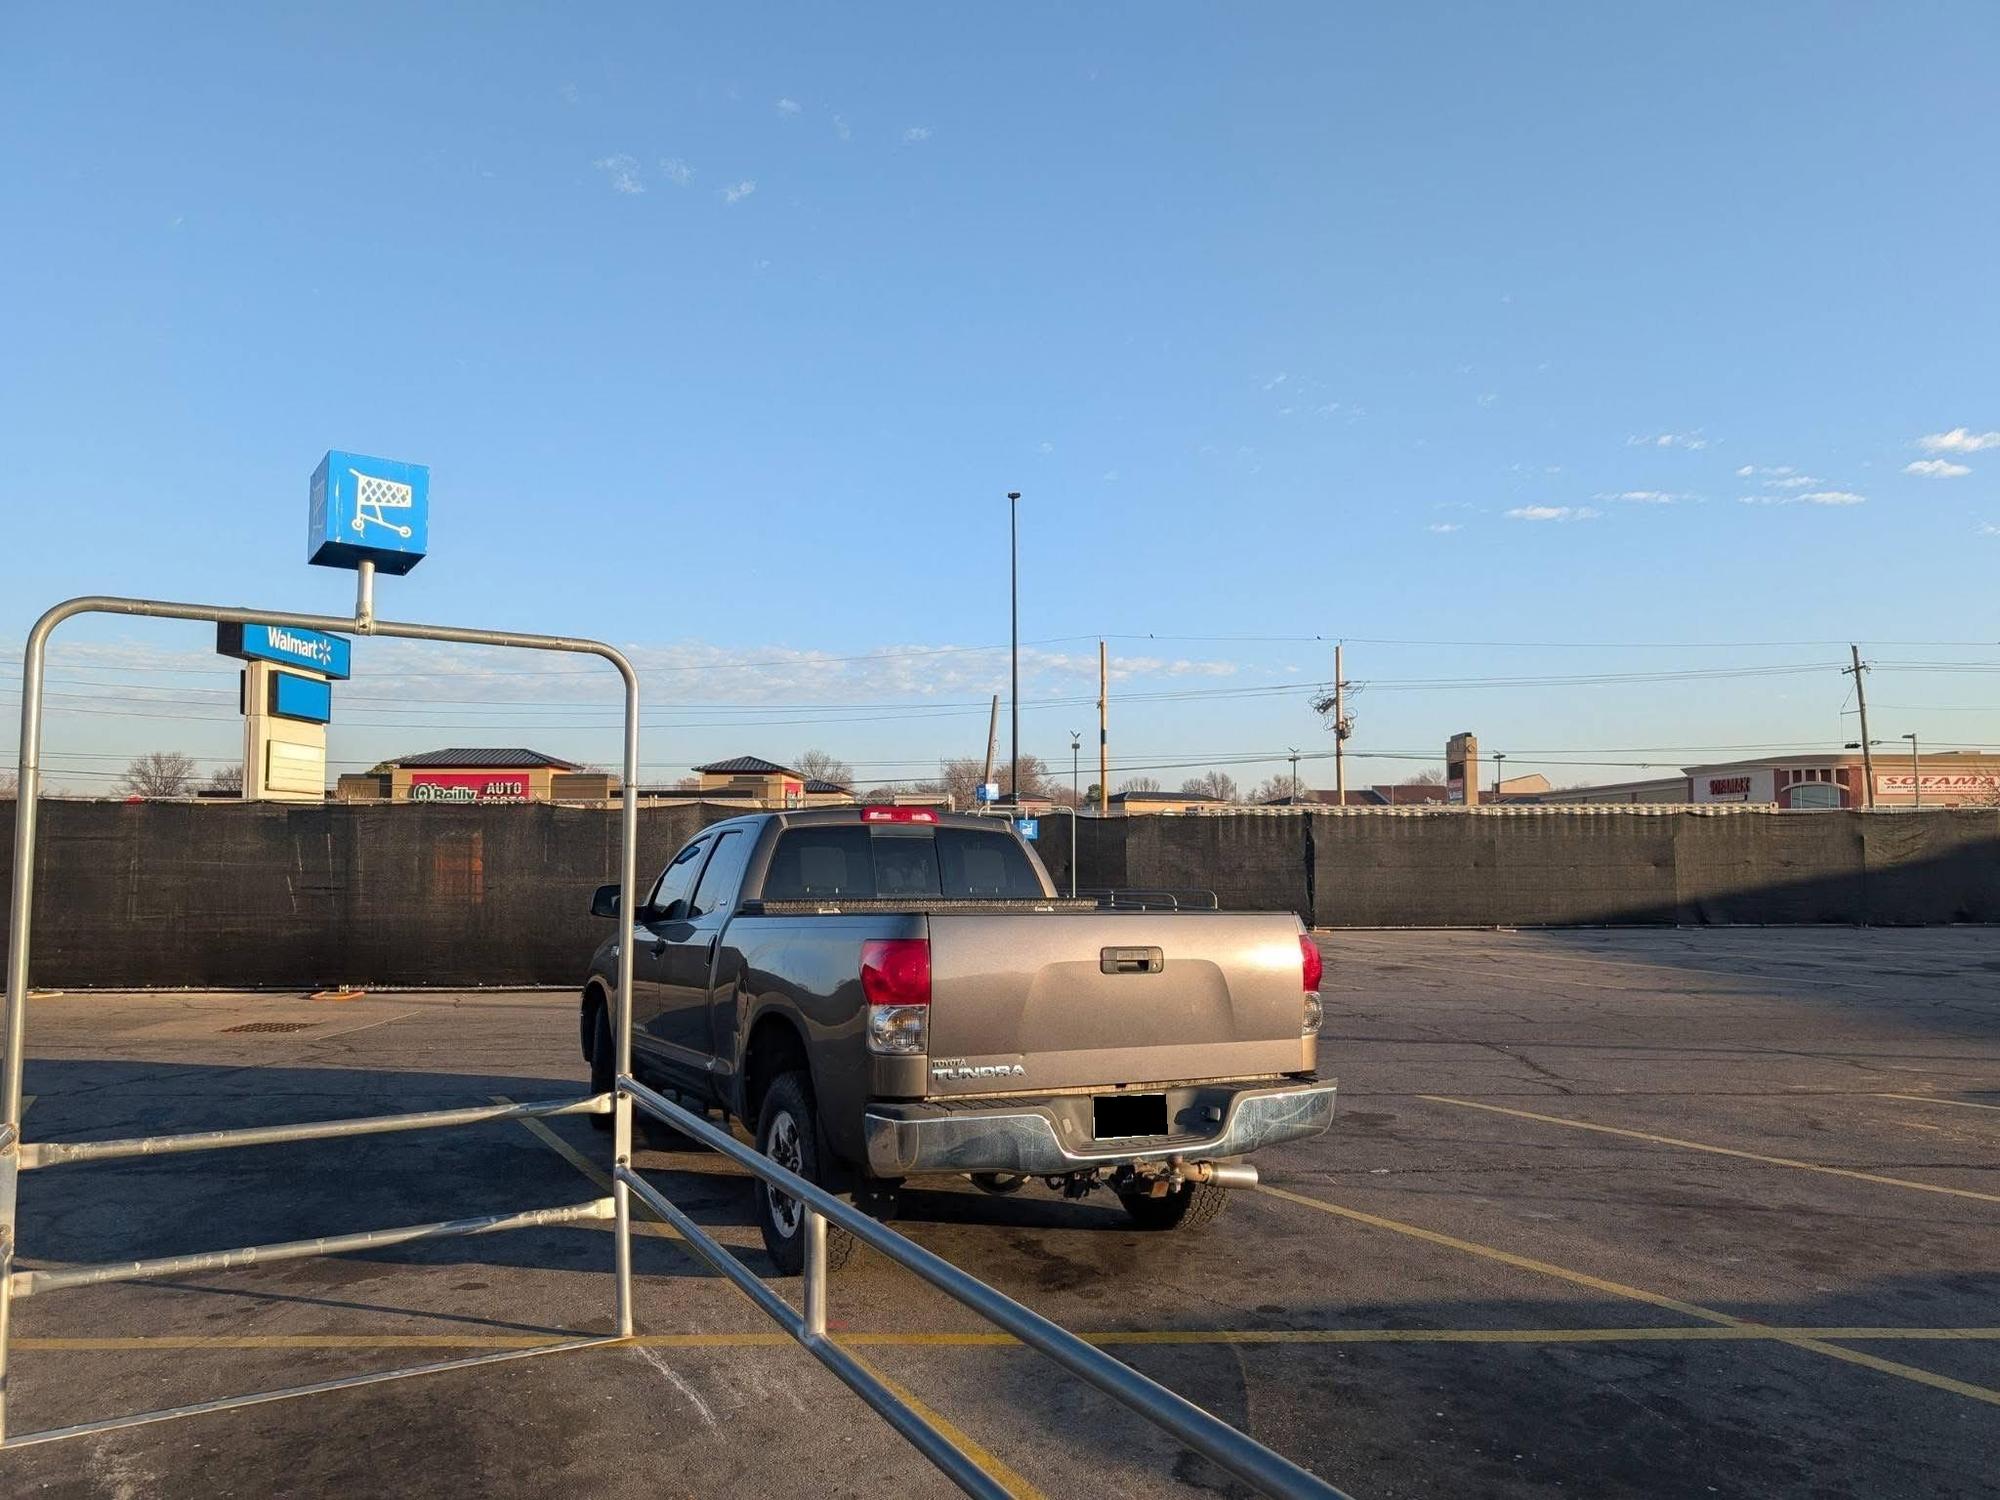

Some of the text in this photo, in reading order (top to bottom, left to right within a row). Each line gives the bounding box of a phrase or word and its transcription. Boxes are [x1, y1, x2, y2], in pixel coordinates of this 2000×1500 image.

[267, 626, 318, 659] Walmart
[486, 782, 522, 795] AUTO
[932, 1058, 967, 1068] TOYOTA
[932, 1064, 1030, 1080] TUNDRA
